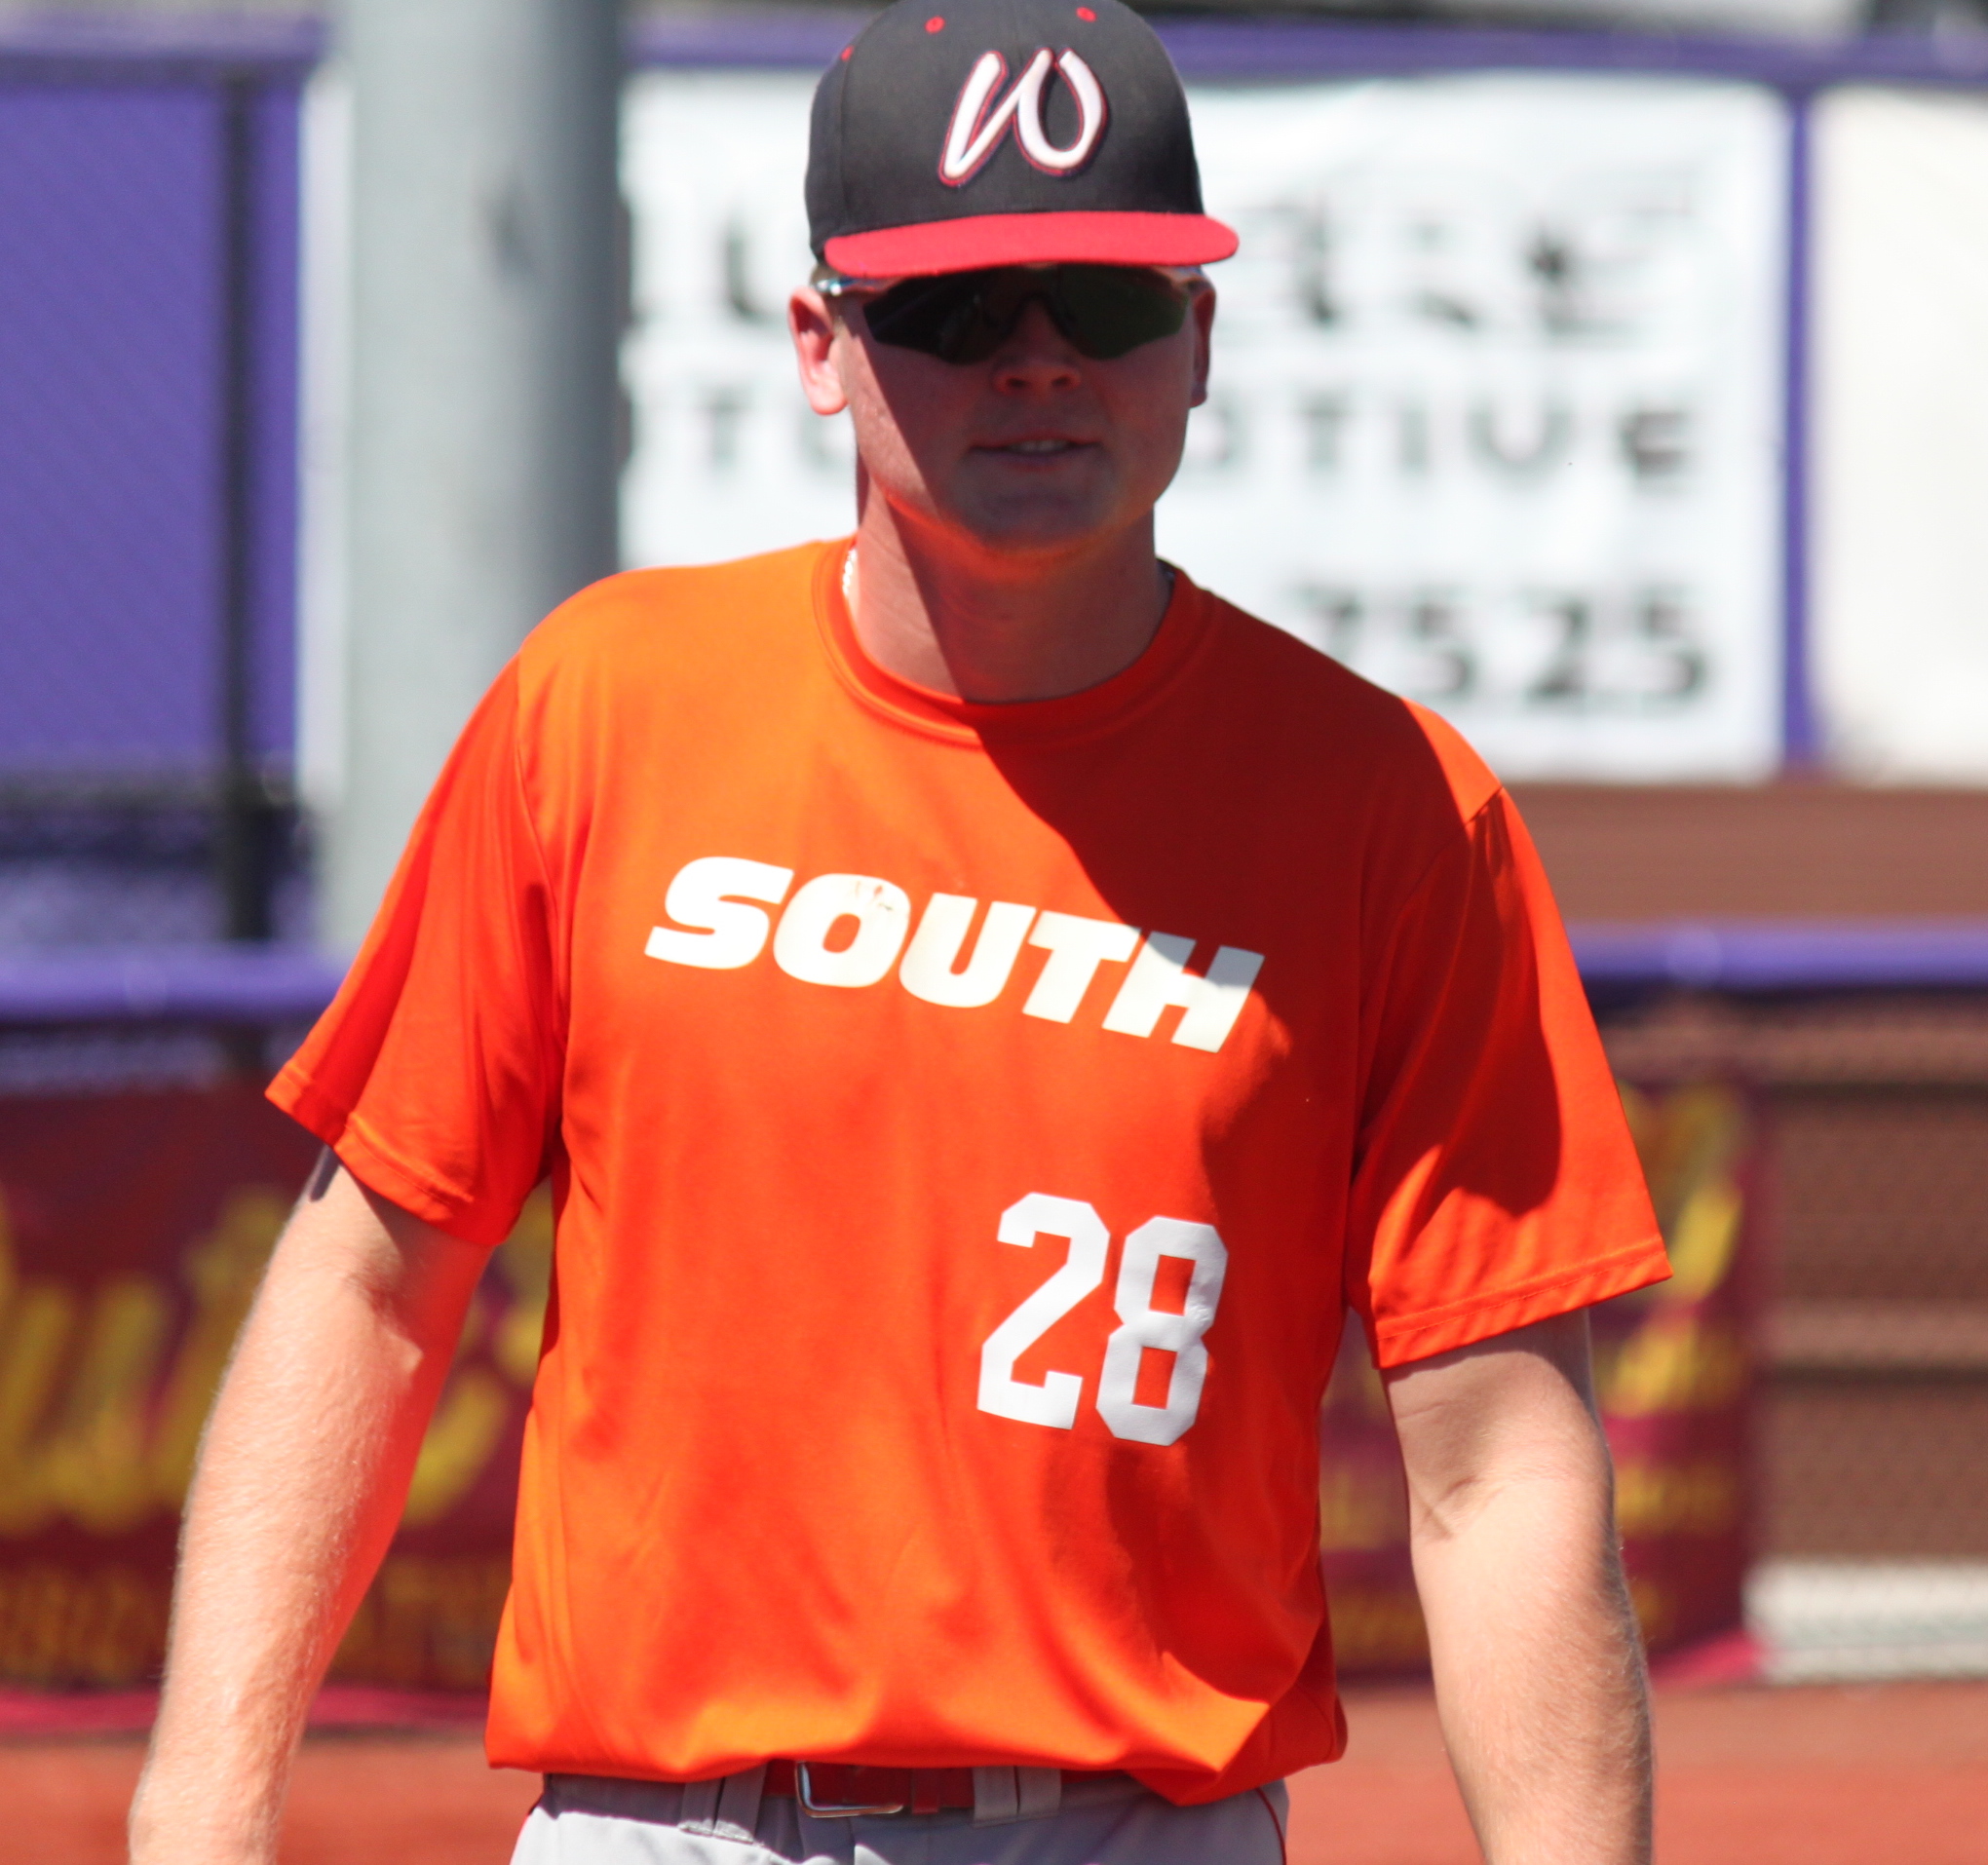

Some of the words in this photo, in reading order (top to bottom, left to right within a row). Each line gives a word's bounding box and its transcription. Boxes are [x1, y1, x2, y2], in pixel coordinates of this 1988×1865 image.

[938, 48, 1109, 187] W
[644, 856, 1266, 1053] SOUTH
[976, 1191, 1229, 1447] 28
